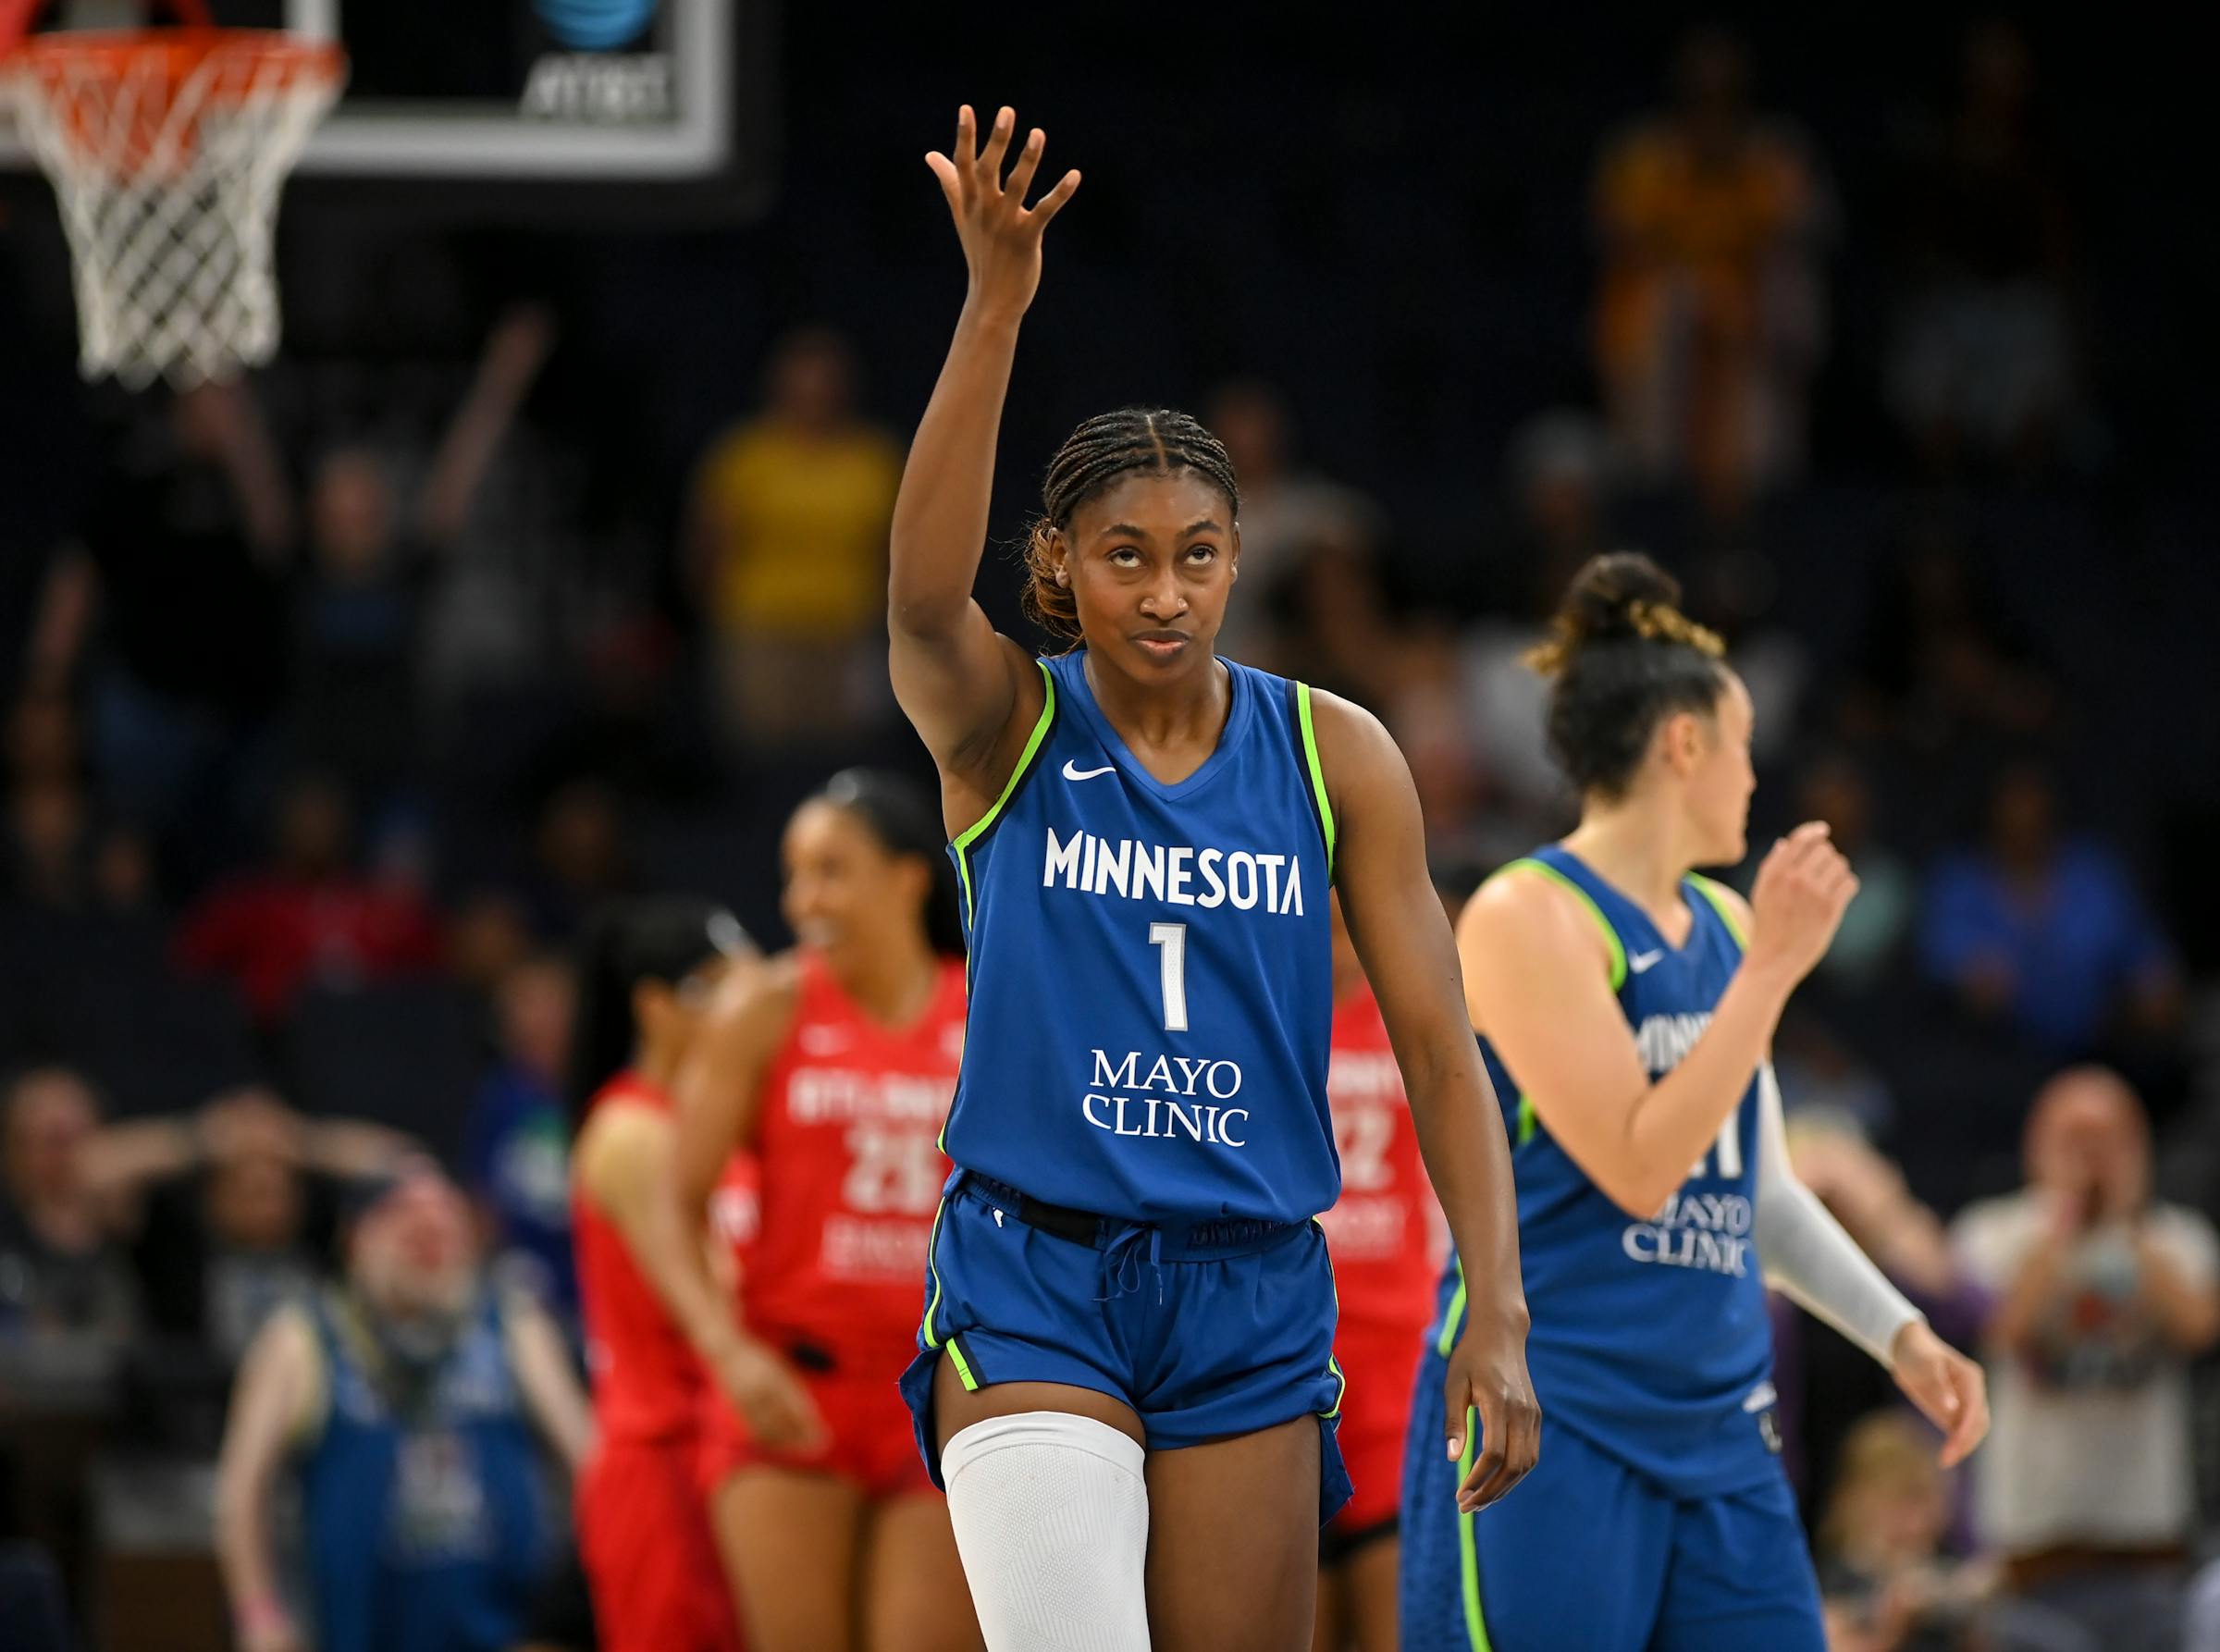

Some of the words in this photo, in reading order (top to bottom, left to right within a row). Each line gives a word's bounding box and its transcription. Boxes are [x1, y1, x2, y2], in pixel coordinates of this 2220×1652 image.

[1042, 827, 1304, 917] MINNESOTA
[1148, 921, 1188, 1032] 1
[1090, 1049, 1242, 1099] MAYO
[1082, 1093, 1249, 1147] CLINIC
